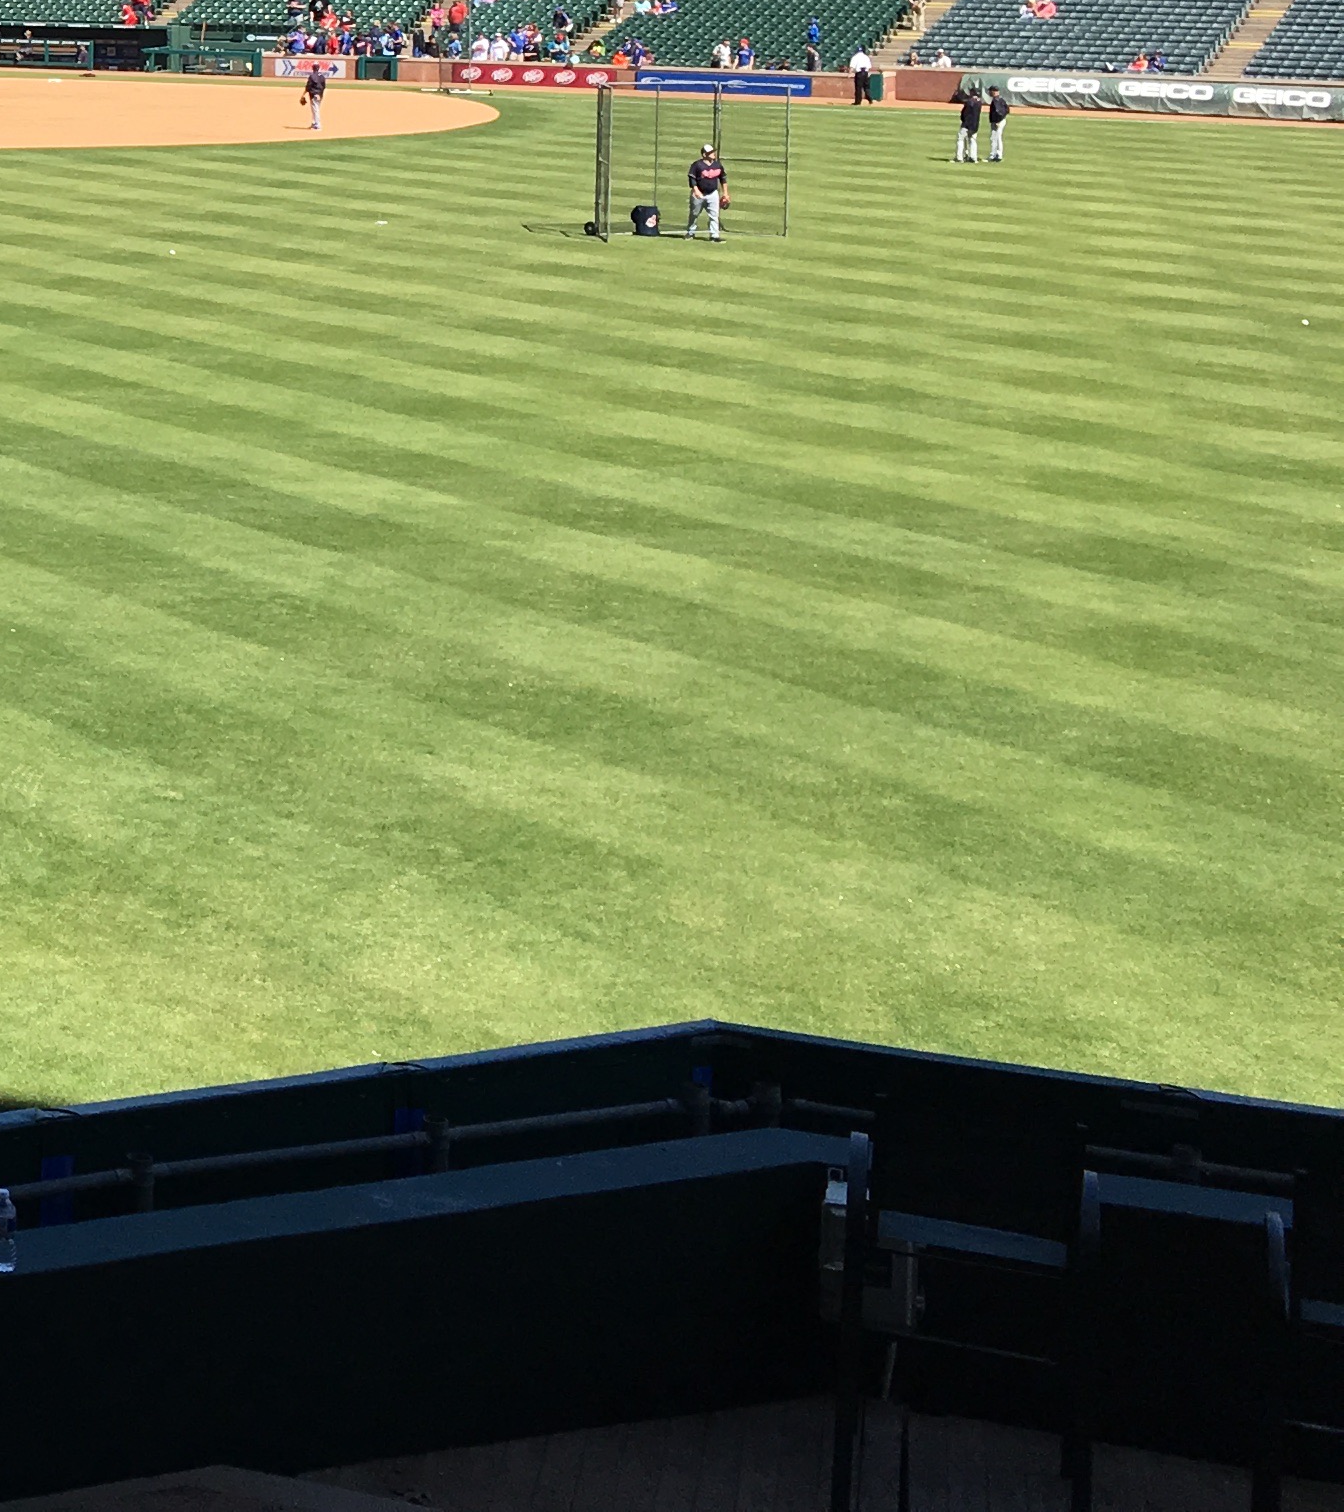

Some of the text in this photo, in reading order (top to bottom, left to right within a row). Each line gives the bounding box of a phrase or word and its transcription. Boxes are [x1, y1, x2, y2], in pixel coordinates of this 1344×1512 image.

[1007, 76, 1331, 108] GEICO GEICO GEICO
